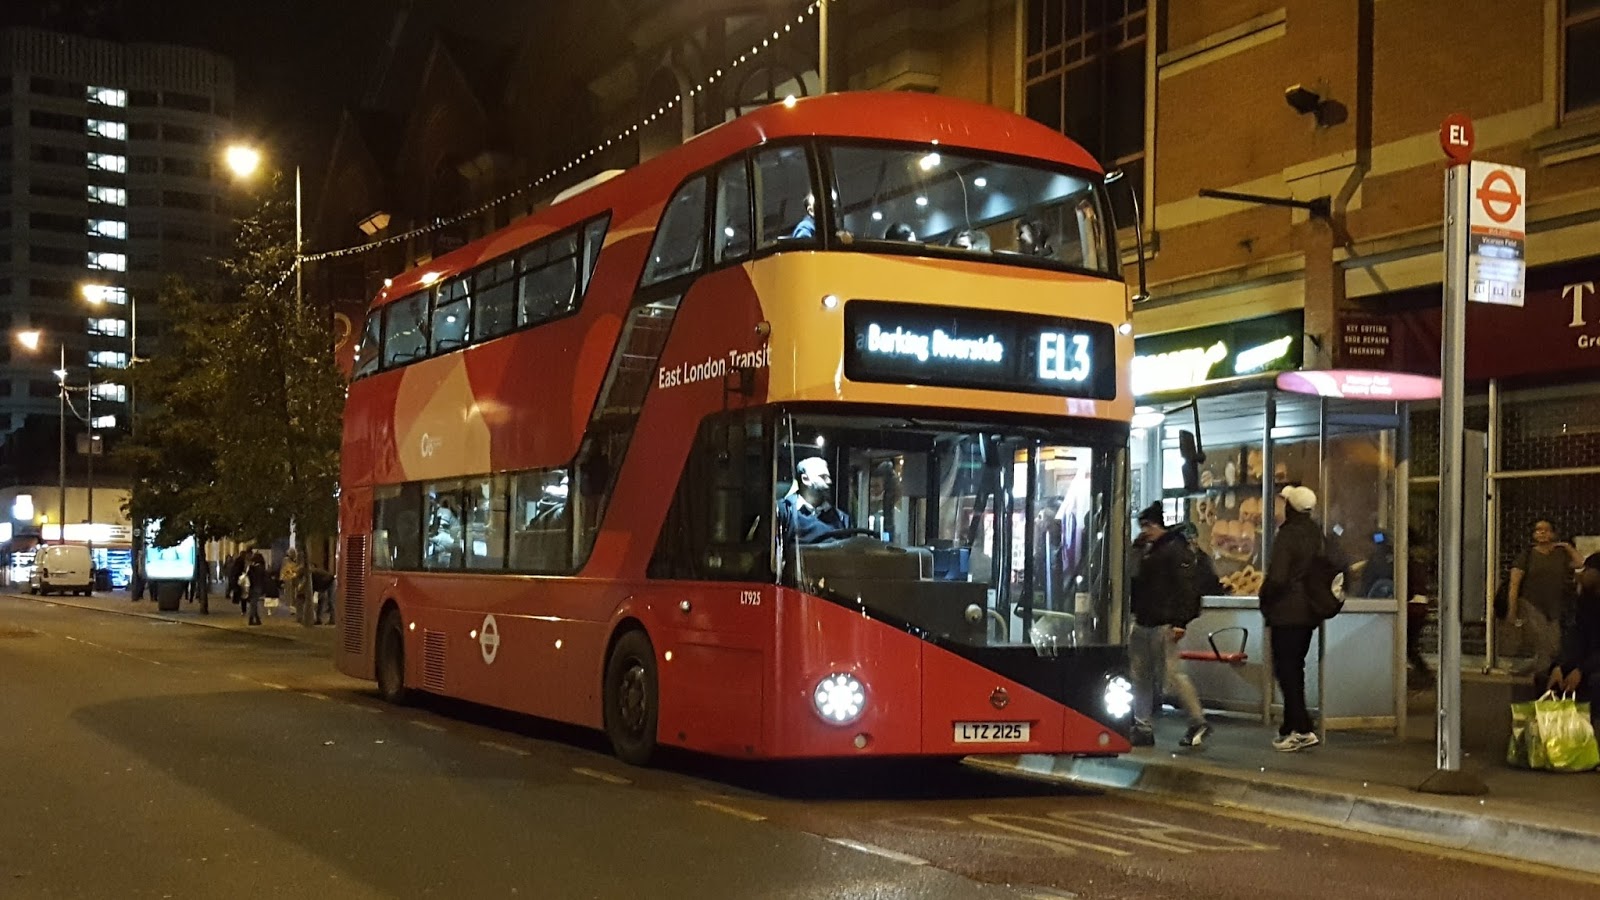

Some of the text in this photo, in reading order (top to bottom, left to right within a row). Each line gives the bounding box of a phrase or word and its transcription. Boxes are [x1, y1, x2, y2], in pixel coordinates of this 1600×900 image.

[1449, 125, 1469, 146] EL
[1562, 281, 1600, 328] T
[1346, 324, 1359, 333] KEY
[1344, 335, 1361, 343] SHOE
[867, 323, 929, 362] Barking
[932, 329, 1004, 362] Riverside
[1039, 332, 1091, 381] EL3
[1349, 347, 1385, 355] ENGRAVING
[658, 343, 772, 389] East London Transit
[740, 591, 761, 606] LT925
[963, 724, 1022, 739] LTZ 2125
